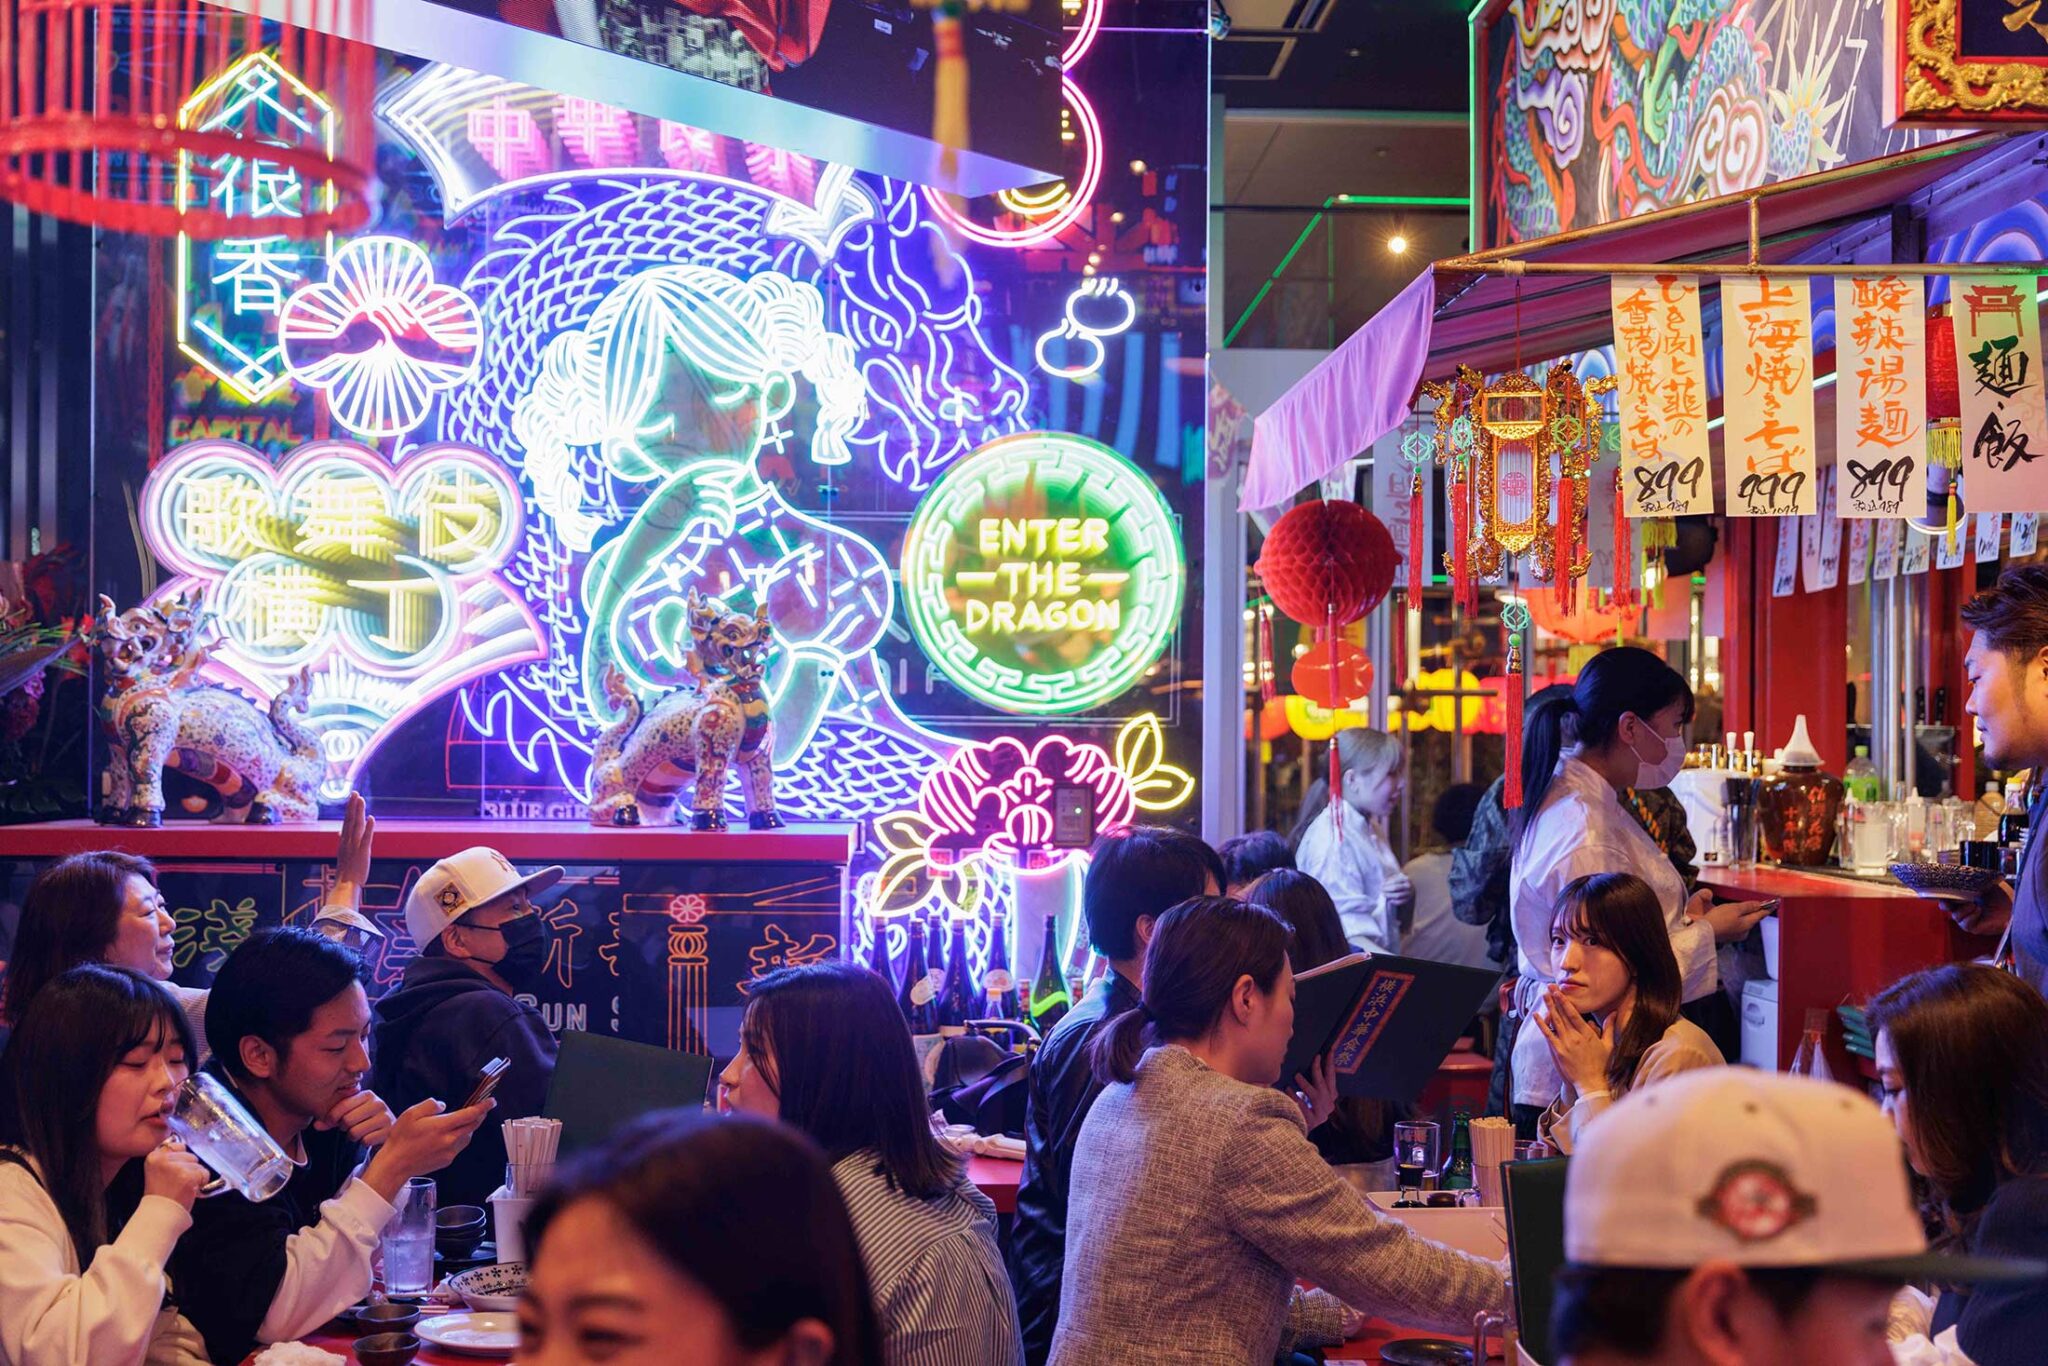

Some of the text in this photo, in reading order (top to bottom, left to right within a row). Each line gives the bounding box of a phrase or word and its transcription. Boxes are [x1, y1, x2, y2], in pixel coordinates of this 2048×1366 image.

[1616, 287, 1668, 463] 香港焼きそば
[1738, 275, 1808, 476] 上海焼きそば
[169, 414, 304, 444] CAPITAL
[1634, 456, 1705, 503] 899
[1737, 471, 1806, 509] 999
[1846, 455, 1915, 502] 899
[176, 465, 502, 557] 歌舞伎
[978, 517, 1110, 557] ENTER
[999, 561, 1082, 596] THE
[223, 562, 438, 653] 横丁
[964, 599, 1121, 633] DRAGON
[484, 801, 590, 819] BLUE GIR
